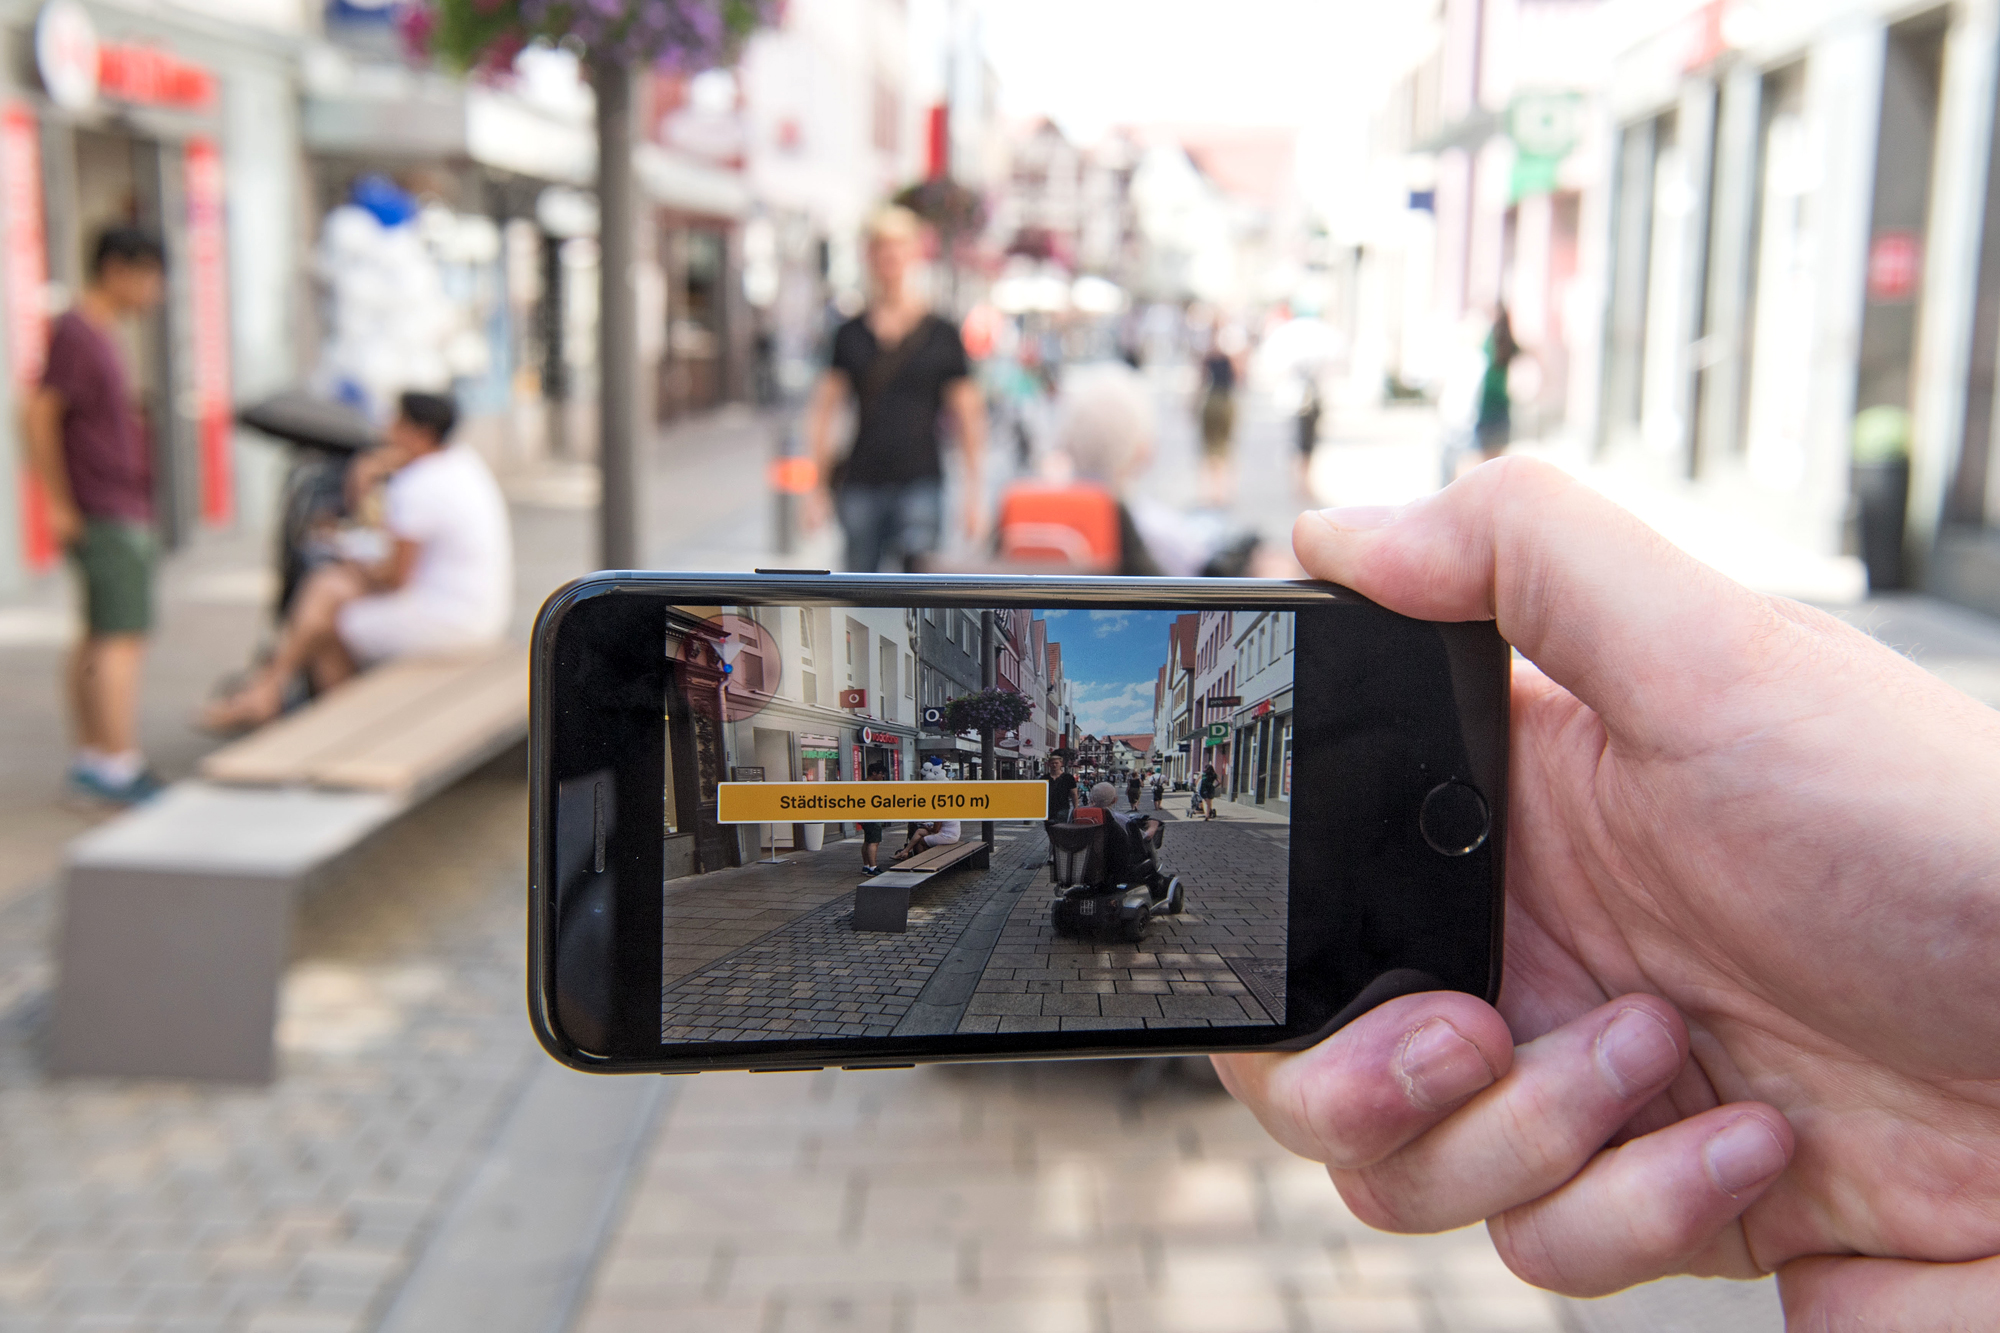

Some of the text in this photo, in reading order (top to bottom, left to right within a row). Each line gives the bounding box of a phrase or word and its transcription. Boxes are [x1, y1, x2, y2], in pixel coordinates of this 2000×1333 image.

[780, 794, 990, 810] Städtische Galerie (510 m)
